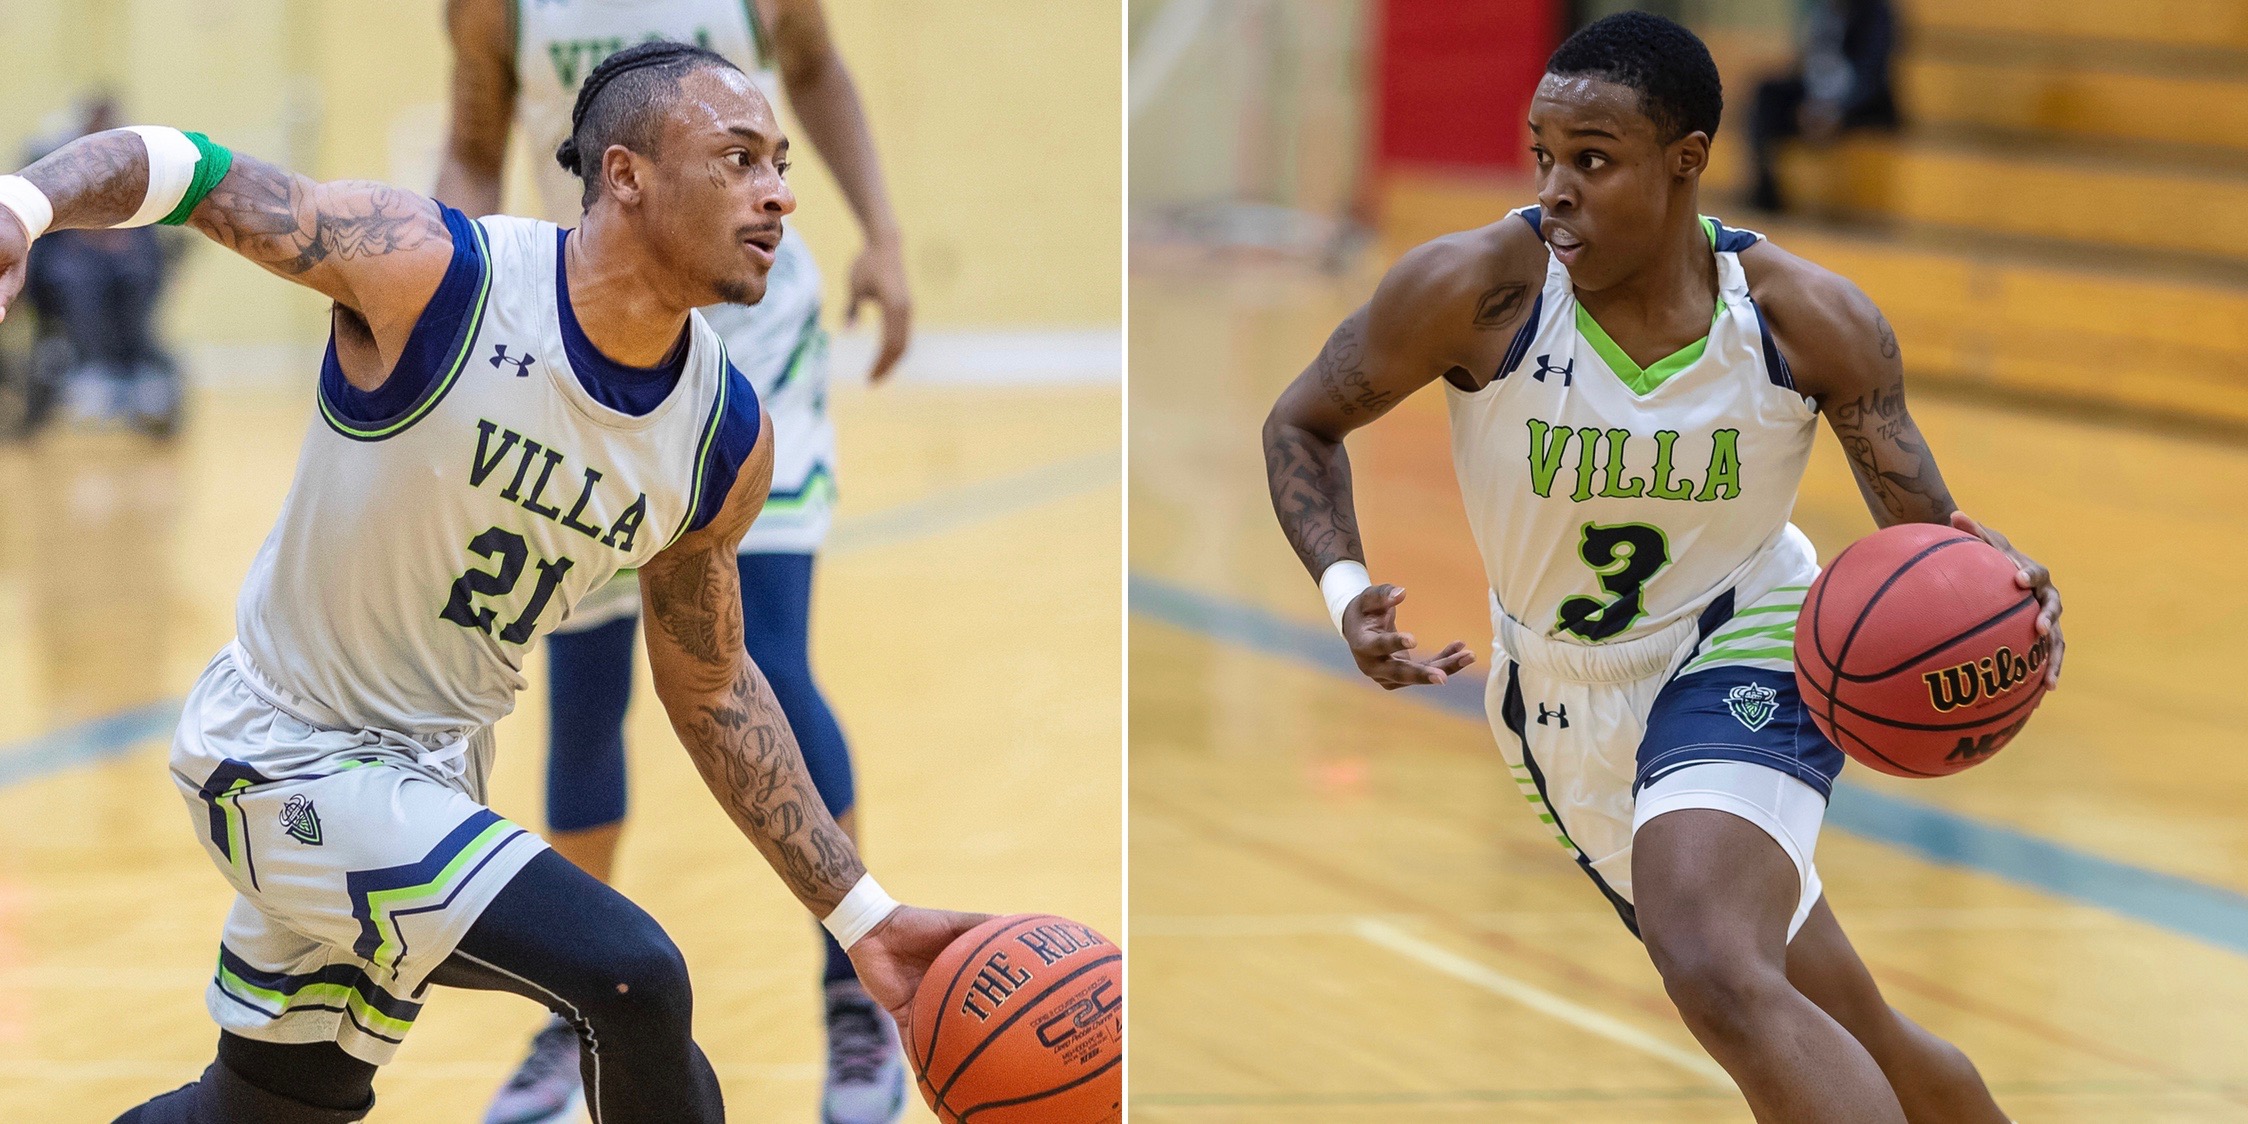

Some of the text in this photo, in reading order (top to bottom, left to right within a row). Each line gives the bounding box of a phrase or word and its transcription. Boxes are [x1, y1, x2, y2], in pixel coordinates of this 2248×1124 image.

[469, 418, 646, 552] VILLA
[1525, 417, 1742, 503] VILLA
[438, 526, 575, 645] 21
[1554, 520, 1674, 643] 3
[961, 923, 1105, 1024] THE ROCK
[1036, 979, 1122, 1048] C2C
